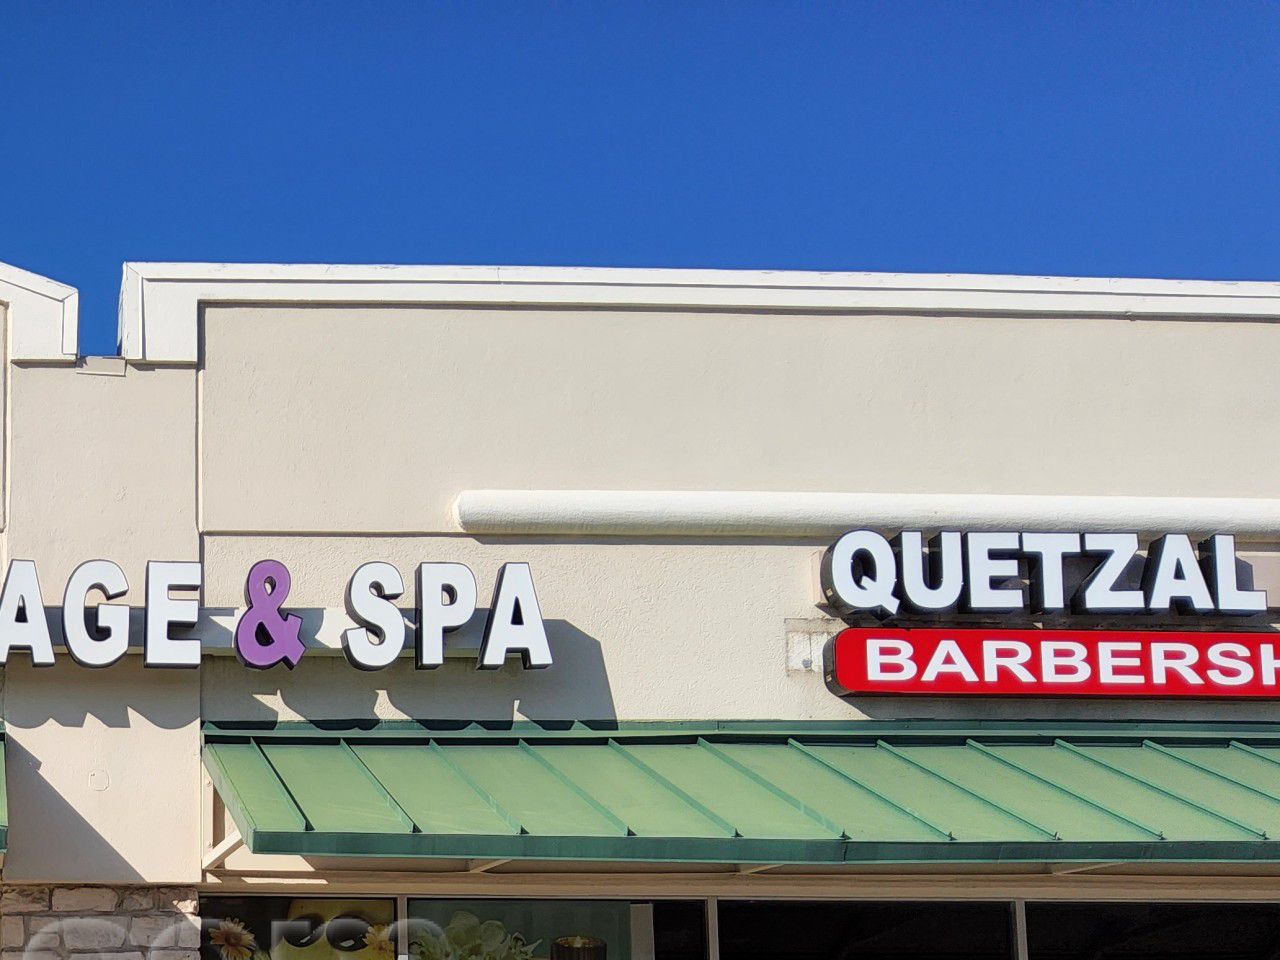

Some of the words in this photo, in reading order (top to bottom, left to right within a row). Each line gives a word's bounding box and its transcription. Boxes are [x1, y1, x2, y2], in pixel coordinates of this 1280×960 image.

[234, 559, 307, 671] &
[343, 561, 554, 669] SPA
[830, 529, 1267, 616] QUETZAL
